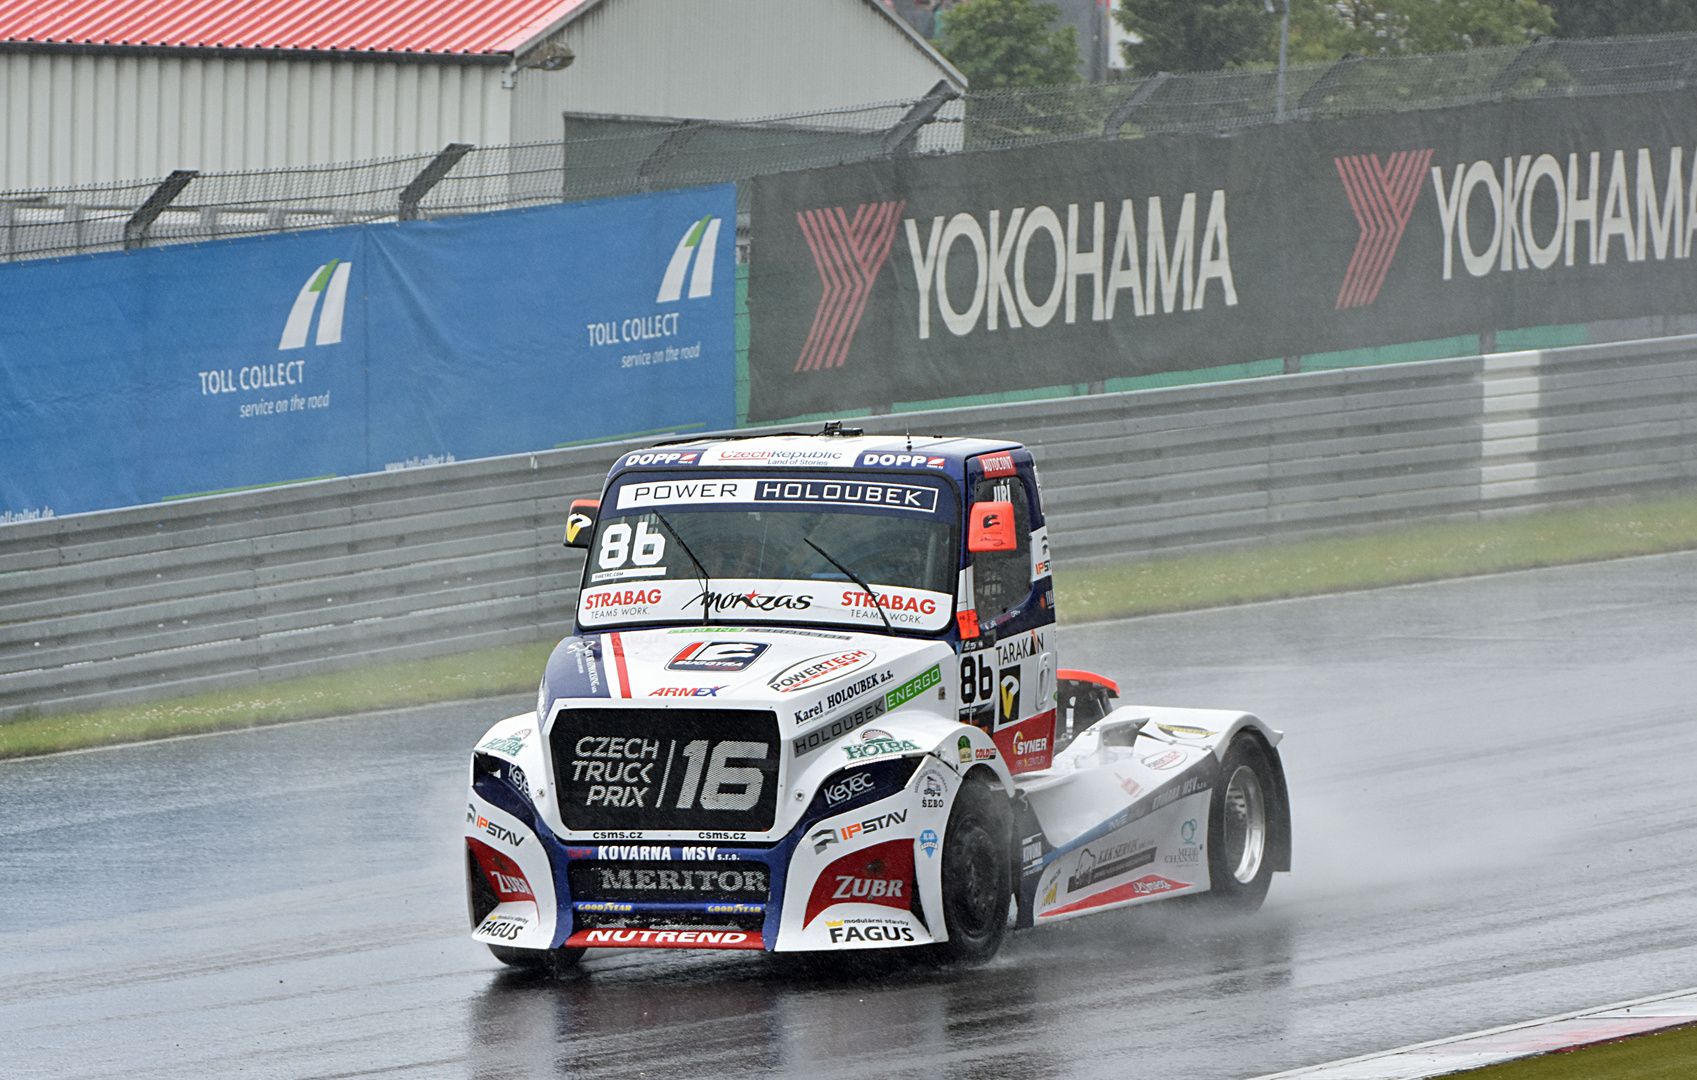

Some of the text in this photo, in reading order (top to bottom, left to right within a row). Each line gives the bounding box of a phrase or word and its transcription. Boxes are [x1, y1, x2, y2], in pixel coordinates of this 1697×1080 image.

[904, 190, 1239, 339] YOKOHAMA
[587, 312, 680, 347] TOLL COLLECT
[621, 341, 701, 368] service on the road
[198, 360, 305, 395] TOLL COLLECT
[240, 390, 330, 418] service on the road
[625, 453, 682, 467] DOPP
[800, 458, 828, 466] Stories
[863, 453, 927, 467] DOPP
[981, 456, 1013, 472] AUTOCONT
[634, 484, 737, 501] POWER
[763, 483, 922, 506] HOLOUBEK
[598, 521, 666, 570] 86
[585, 589, 662, 610] STRABAG
[841, 591, 937, 615] STRABAG
[590, 608, 618, 619] TEAMS
[850, 609, 924, 624] TEAMS WORK.
[770, 650, 868, 692] POWERTECH
[648, 685, 728, 697] ARMEX
[794, 701, 824, 725] Karel
[827, 673, 880, 709] HOLOUBEK
[880, 669, 894, 683] a.s.
[887, 667, 941, 708] ENERGO
[794, 700, 885, 754] HOLOUBEK
[575, 735, 660, 759] CZECH
[842, 739, 923, 760] HOLBA
[1017, 737, 1047, 756] SYNER
[571, 760, 655, 783] TRUCK
[675, 739, 769, 811] 16
[586, 785, 650, 808] PRIX
[823, 771, 875, 805] KeyTec
[922, 798, 944, 808] ŠEBO
[476, 815, 525, 847] IPSTAV
[593, 831, 643, 840] csms.cz
[698, 831, 746, 840] csms.cz
[841, 808, 908, 840] IPSTAV
[682, 846, 717, 861] MSV
[717, 852, 740, 861] s.r.o.
[490, 871, 533, 896] ZUBR
[600, 869, 767, 892] MERITOR
[831, 875, 904, 900] ZUBR
[477, 921, 524, 940] FAGUS
[586, 930, 748, 944] NUTREND
[829, 926, 915, 944] FAGUS
